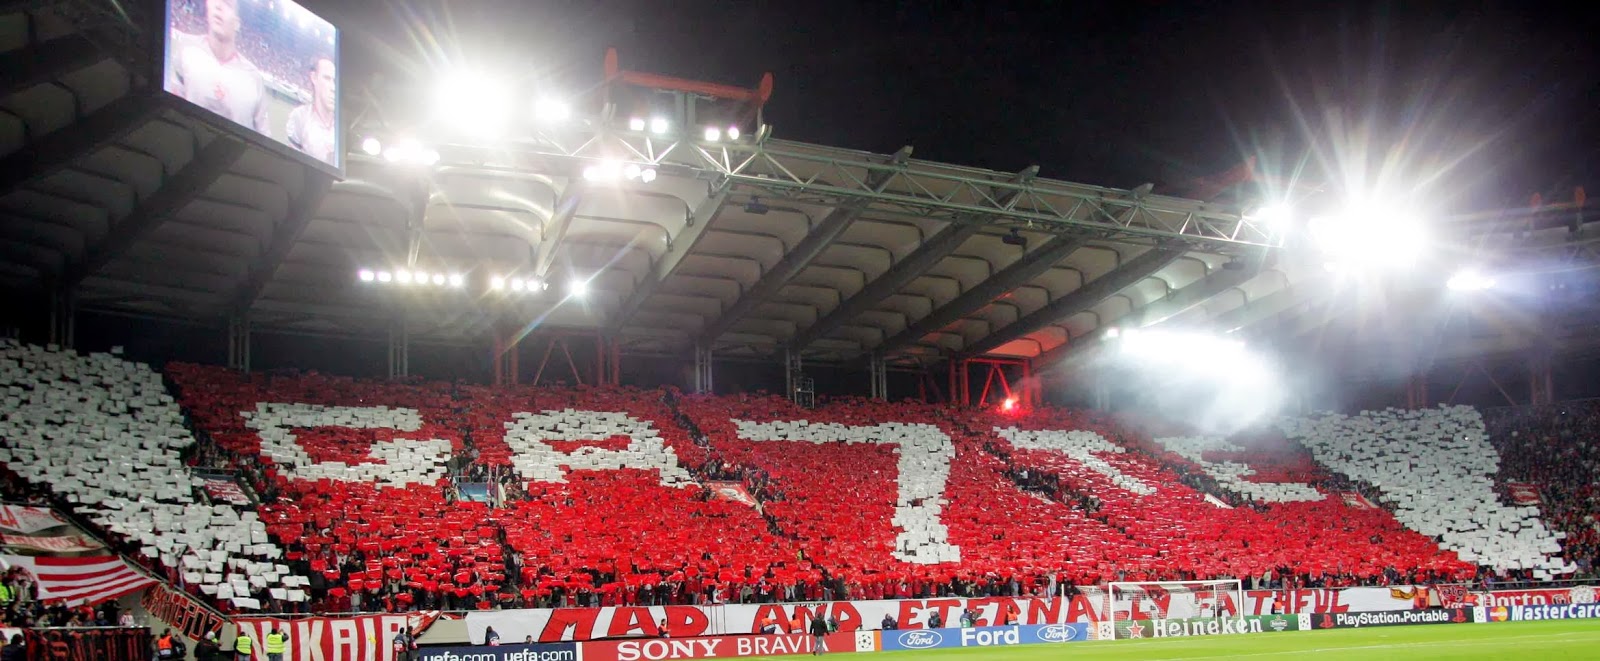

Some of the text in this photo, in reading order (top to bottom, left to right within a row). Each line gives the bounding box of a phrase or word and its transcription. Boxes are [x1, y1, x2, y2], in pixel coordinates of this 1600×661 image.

[537, 605, 709, 642] MAD
[752, 602, 862, 635] AND
[1152, 616, 1263, 638] Heineken
[906, 632, 934, 646] Ford
[961, 626, 1019, 646] Ford
[1045, 626, 1070, 640] Ford
[617, 638, 722, 661] SONY
